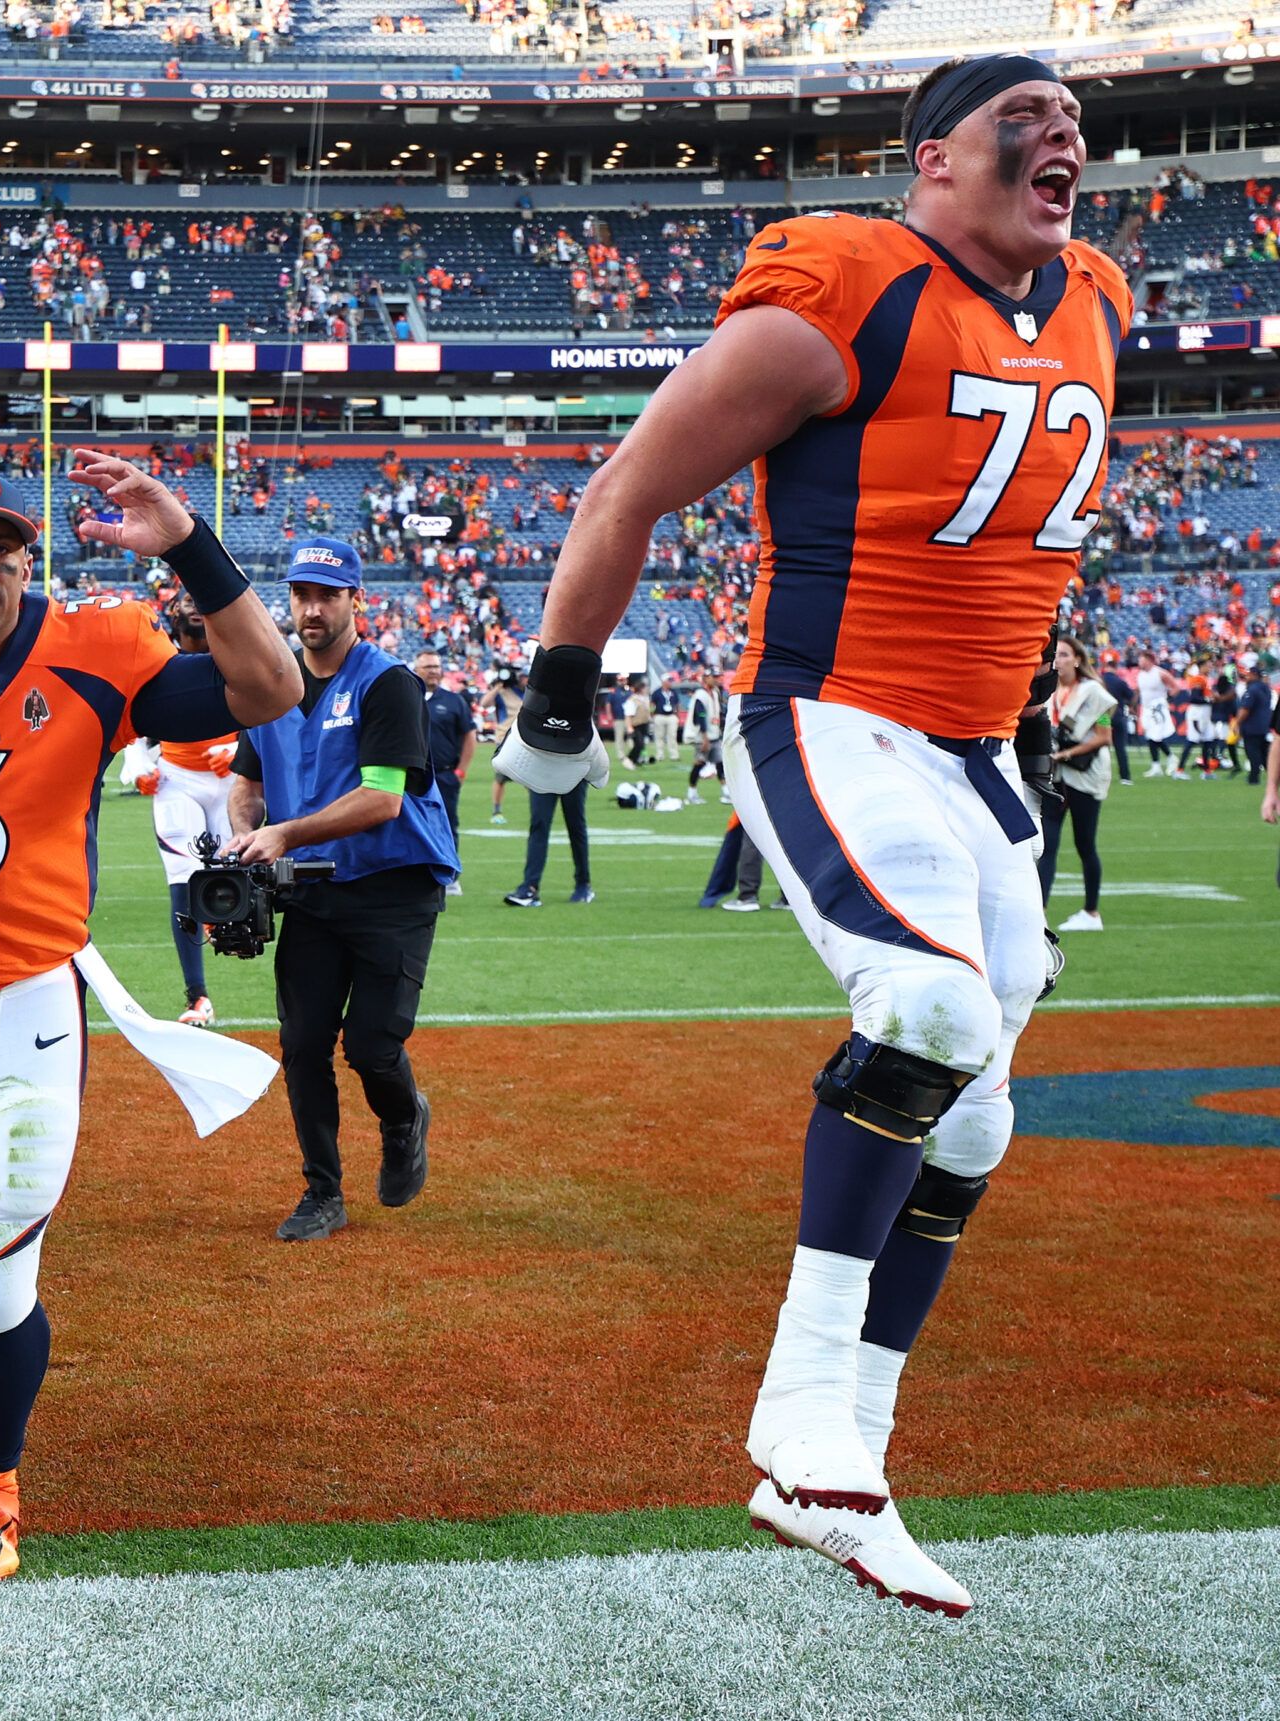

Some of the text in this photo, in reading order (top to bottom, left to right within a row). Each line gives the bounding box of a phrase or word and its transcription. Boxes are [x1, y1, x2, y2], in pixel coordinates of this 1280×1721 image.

[1068, 56, 1144, 76] JACKSON
[716, 82, 794, 95] 15 TURNER
[869, 76, 879, 89] 7
[50, 83, 125, 96] 44 LITTLE
[209, 86, 328, 99] 23 GONSOULIN
[420, 86, 491, 99] TRIPUCKA
[553, 85, 644, 98] 12 JOHNSON
[551, 349, 683, 368] HOMETOWN
[1001, 357, 1064, 370] BRONCOS
[927, 369, 1107, 551] 72
[306, 549, 334, 557] NFL
[305, 554, 343, 567] FILMS
